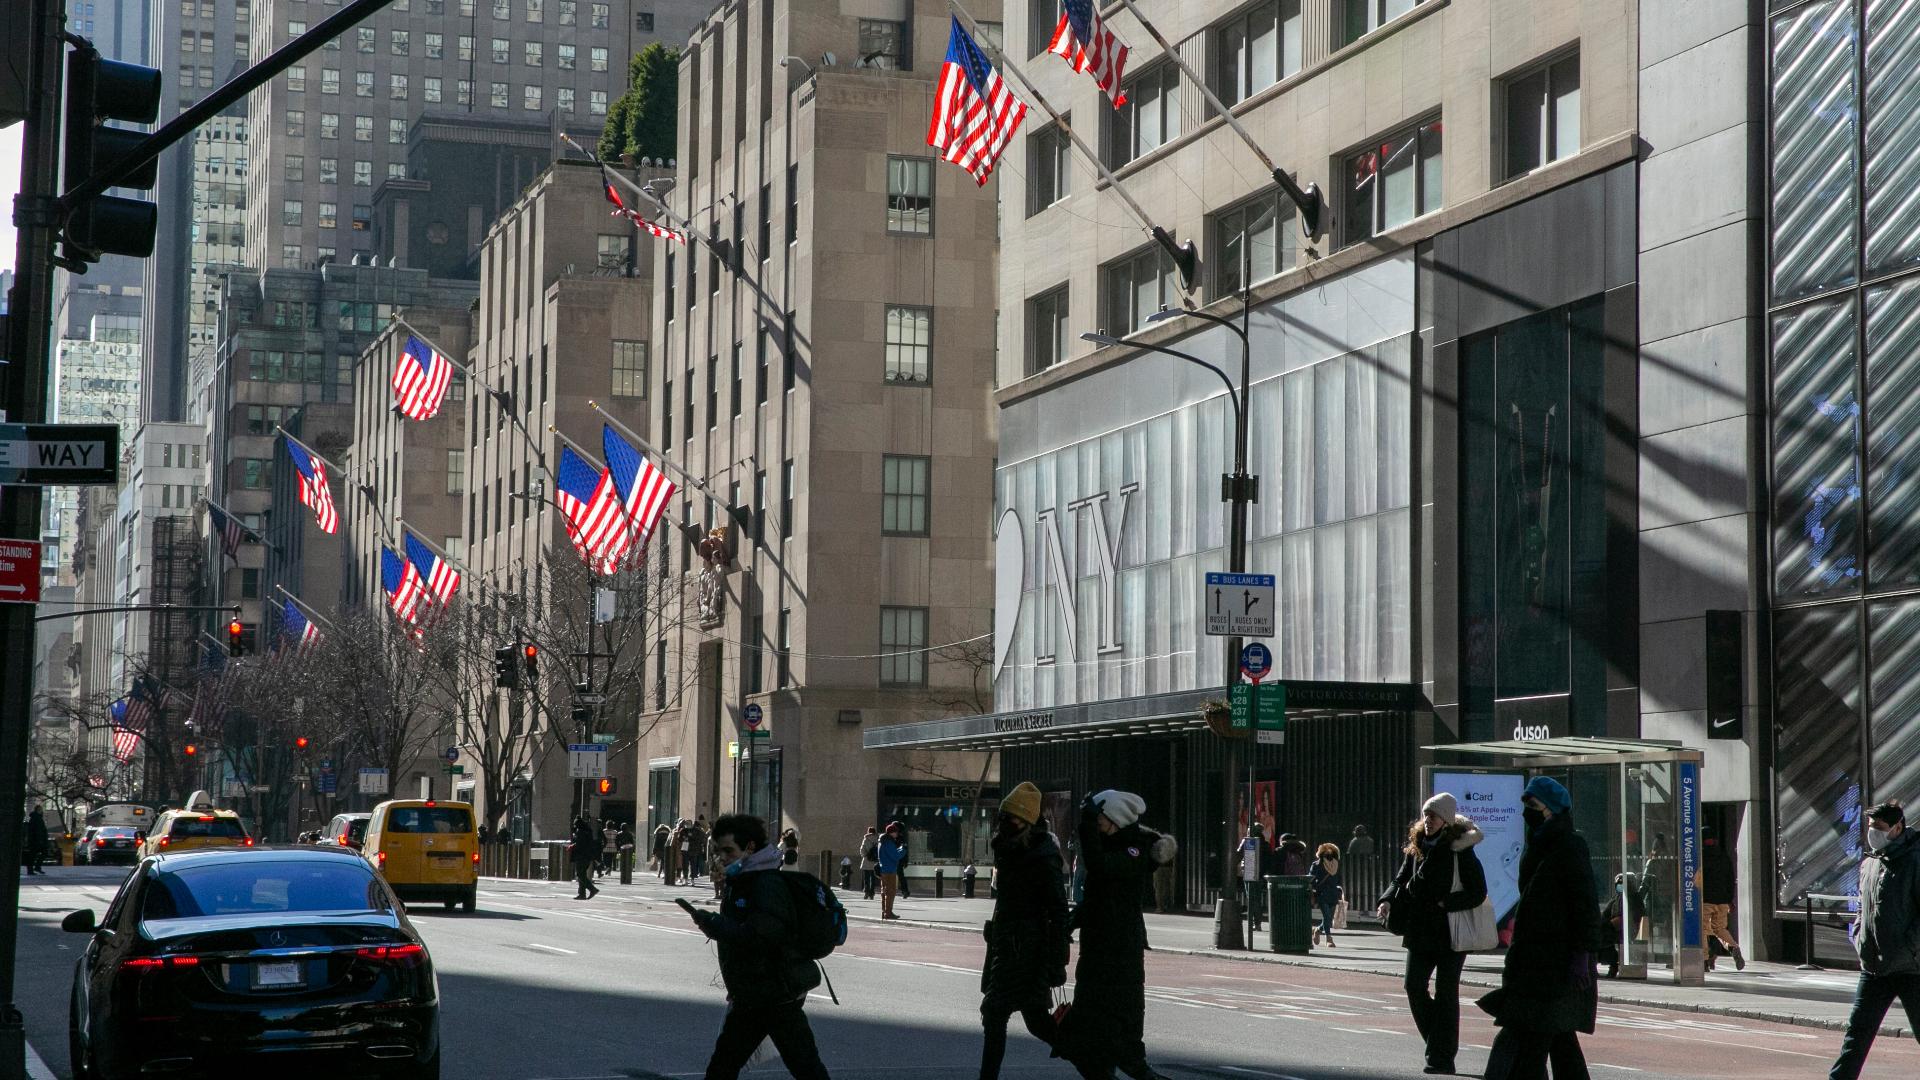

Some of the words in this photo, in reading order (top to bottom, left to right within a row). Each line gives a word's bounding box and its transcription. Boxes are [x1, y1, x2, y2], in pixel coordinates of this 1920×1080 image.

[38, 444, 95, 466] WAY
[1222, 576, 1237, 584] BUS
[1238, 577, 1259, 585] LANES
[1209, 616, 1227, 624] BUSES
[1235, 617, 1252, 625] BUSES
[1211, 625, 1225, 633] ONLY
[1237, 626, 1253, 634] RIGHT
[1232, 686, 1248, 694] x27
[1232, 708, 1247, 716] x37
[1472, 793, 1494, 801] Card
[1683, 787, 1693, 825] Avenue
[1480, 806, 1500, 815] Apple
[1469, 815, 1489, 823] Apple
[1684, 836, 1694, 863] West
[1684, 866, 1694, 878] 52
[1685, 882, 1694, 911] Street
